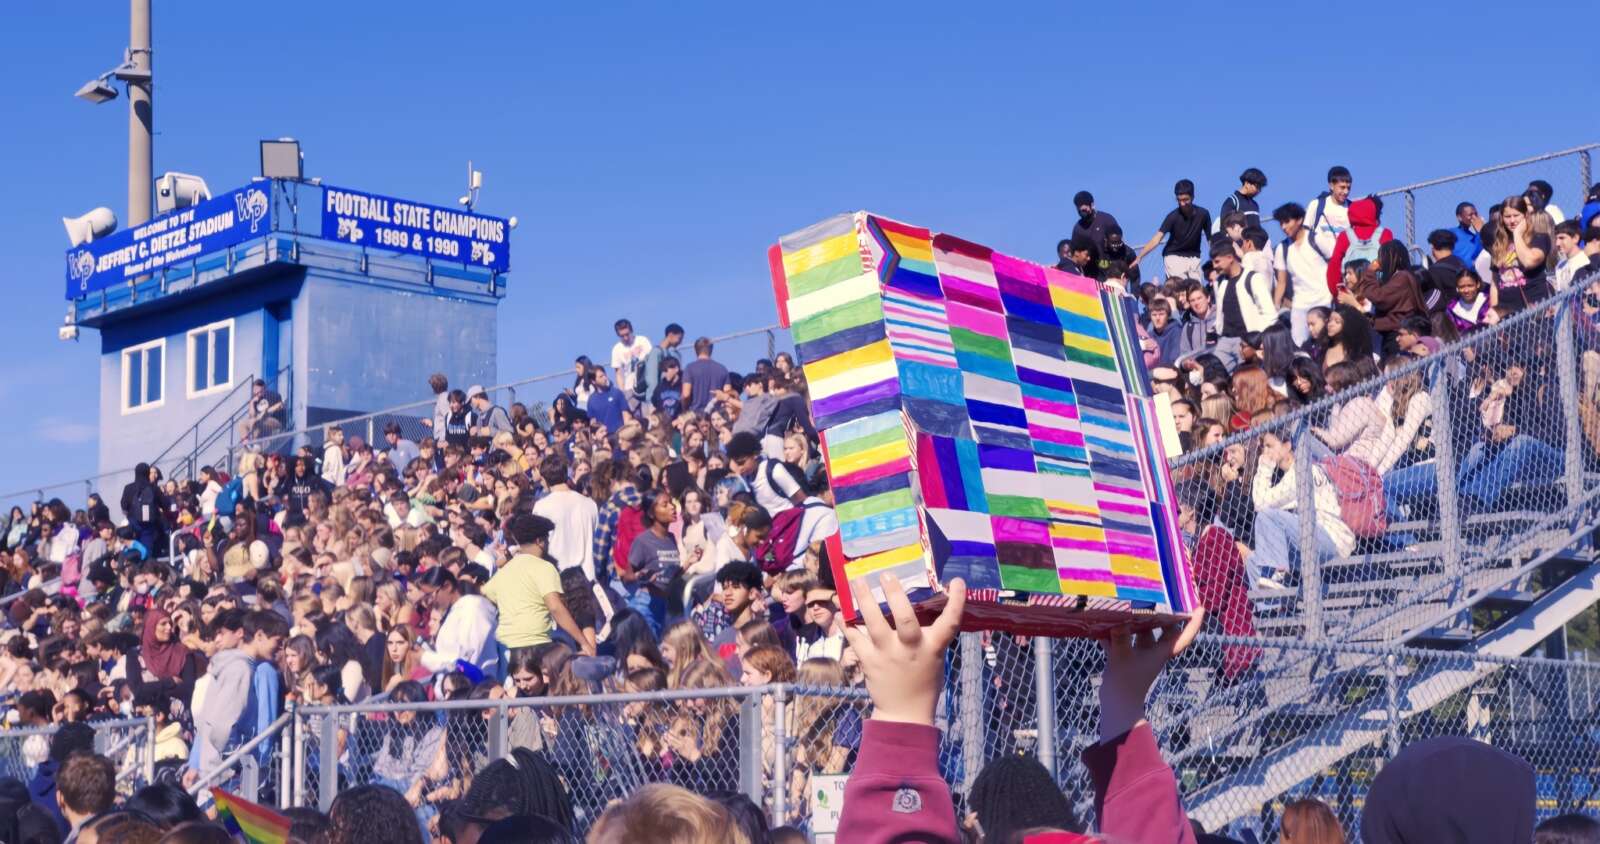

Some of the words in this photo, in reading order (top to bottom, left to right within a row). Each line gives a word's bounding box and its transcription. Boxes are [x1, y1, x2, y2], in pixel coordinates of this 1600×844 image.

[133, 219, 168, 241] WELCOME
[169, 214, 179, 229] TO
[180, 209, 195, 225] THE
[327, 190, 391, 223] FOOTBALL
[393, 202, 430, 230] STATE
[433, 210, 504, 244] CHAMPIONS
[96, 243, 138, 273] JEFFREY
[139, 241, 149, 258] C.
[150, 227, 187, 255] DIETZE
[188, 210, 234, 242] STADIUM
[375, 227, 408, 248] 1989
[411, 233, 423, 251] &
[426, 236, 459, 257] 1990
[144, 256, 153, 270] of
[152, 255, 165, 267] the
